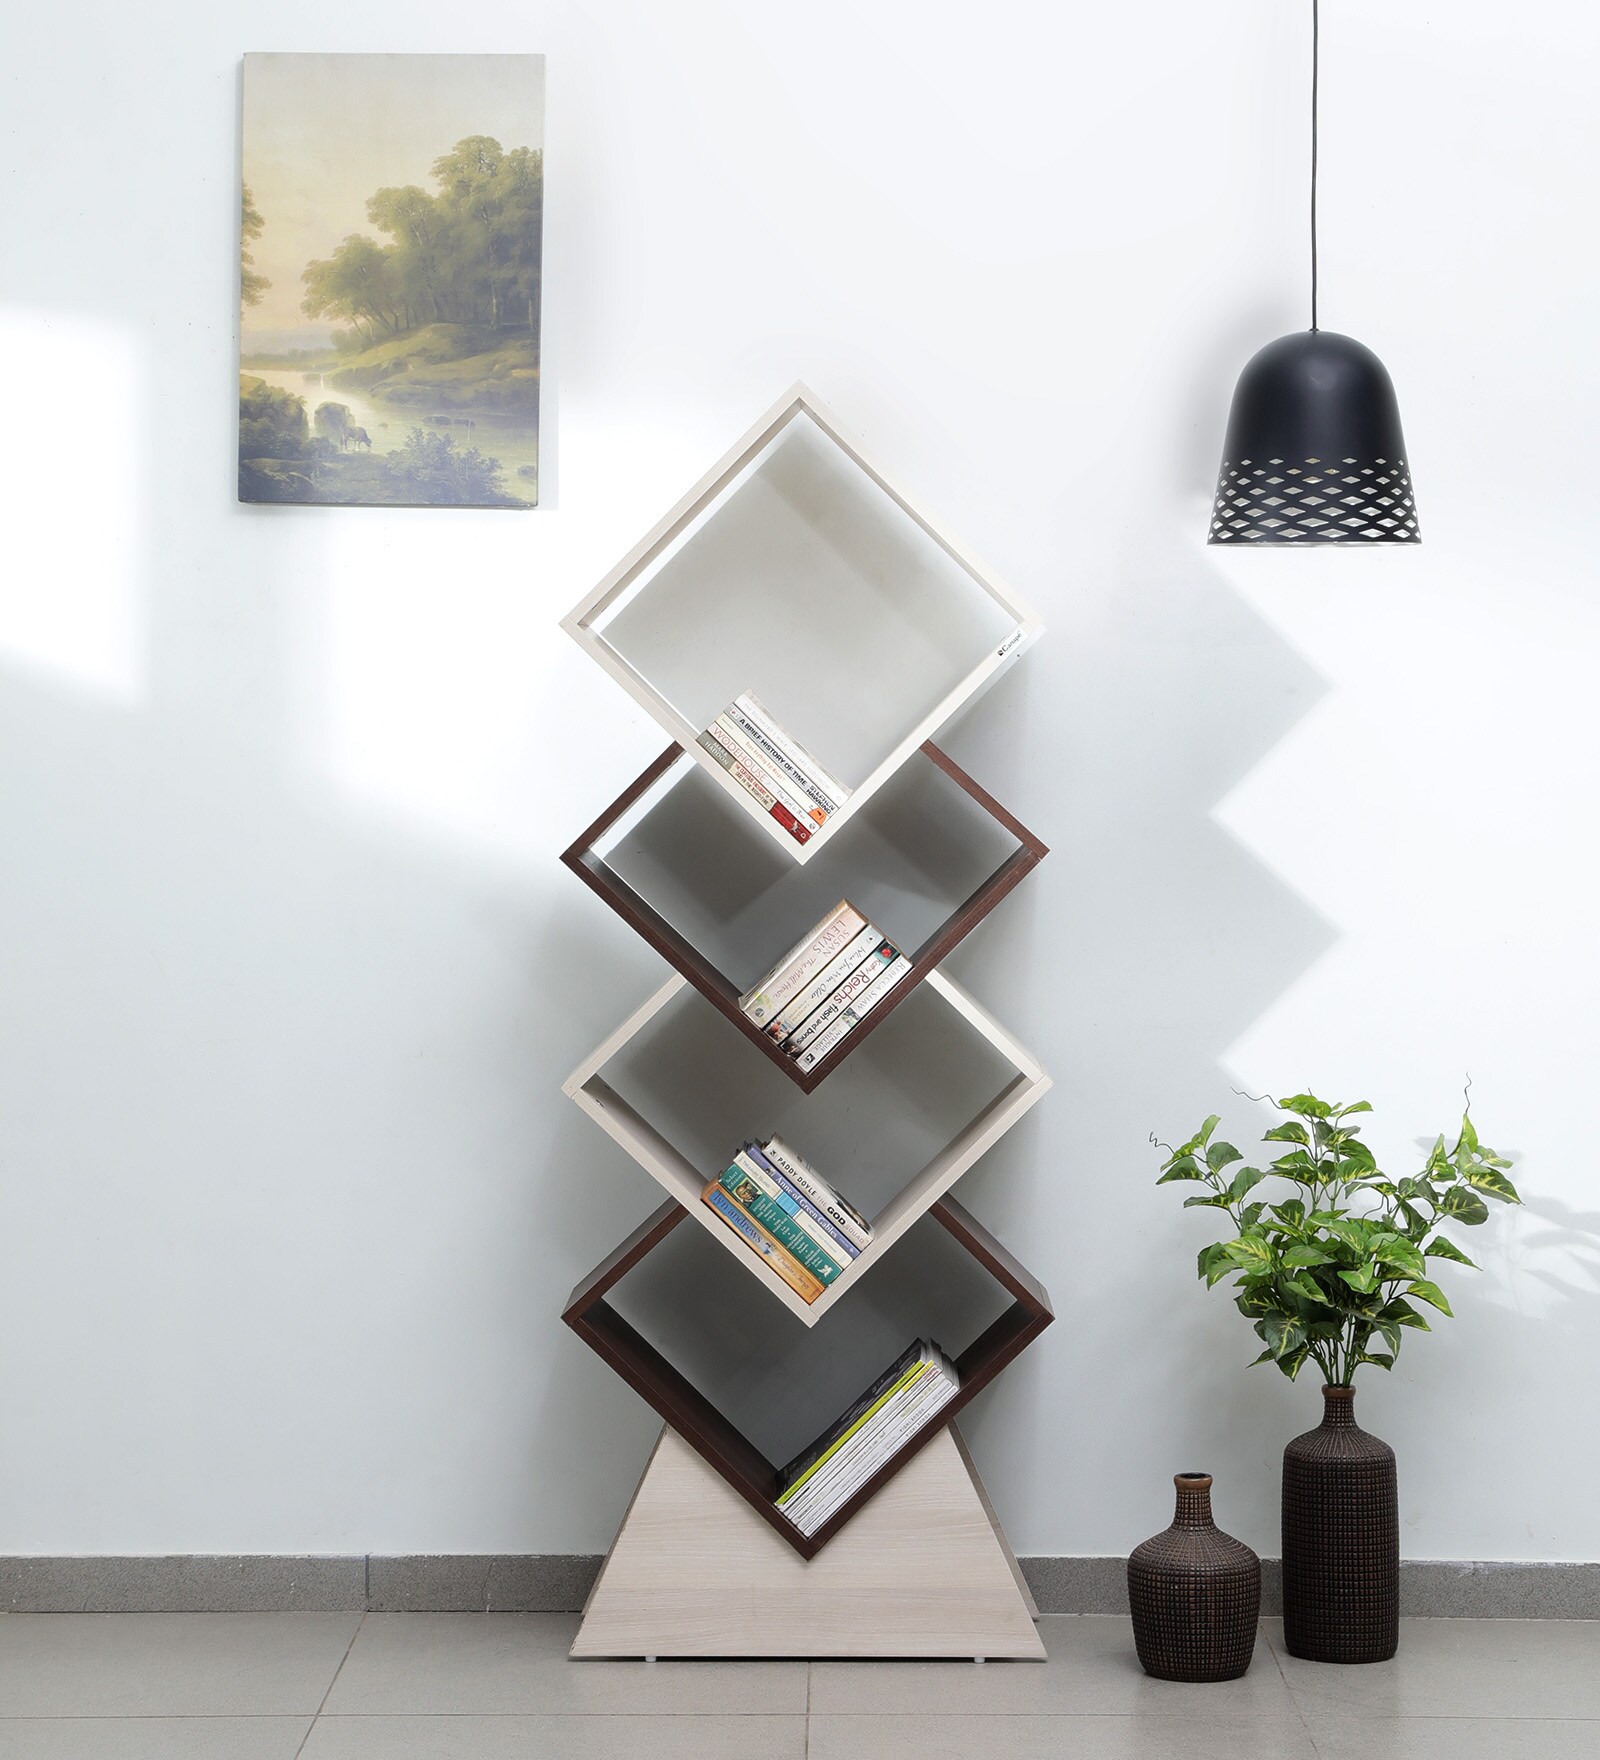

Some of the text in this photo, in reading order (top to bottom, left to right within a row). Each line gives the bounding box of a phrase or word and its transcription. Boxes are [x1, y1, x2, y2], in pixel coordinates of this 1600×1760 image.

[704, 741, 729, 765] HADDON
[712, 727, 768, 782] WODEHOUSE
[738, 717, 746, 725] A
[743, 722, 762, 741] BRIEF
[759, 738, 786, 764] HISTORY
[782, 761, 793, 772] OF
[791, 770, 808, 786] TIME
[805, 788, 832, 814] HAWKING
[809, 784, 835, 810] STEPHEN
[811, 919, 845, 954] LEWIS
[822, 929, 850, 957] SUSAN
[788, 966, 805, 984] Mill
[800, 955, 816, 970] The
[875, 961, 906, 993] REBECCA
[809, 982, 828, 1002] Older
[832, 956, 883, 1008] Kathy Reichs
[855, 989, 878, 1012] SHAW
[795, 1002, 839, 1046] flash and bones
[813, 1030, 833, 1050] VILLAGE
[775, 1175, 794, 1194] Anne
[790, 1191, 801, 1201] of
[798, 1197, 819, 1219] Green
[816, 1215, 839, 1239] Gables
[777, 1156, 797, 1177] PADDY
[796, 1176, 817, 1196] DOYLE
[816, 1195, 826, 1206] THE
[826, 1205, 846, 1225] GOD
[844, 1224, 864, 1244] SQUAD
[711, 1192, 731, 1212] lyn
[726, 1205, 765, 1244] andrews
